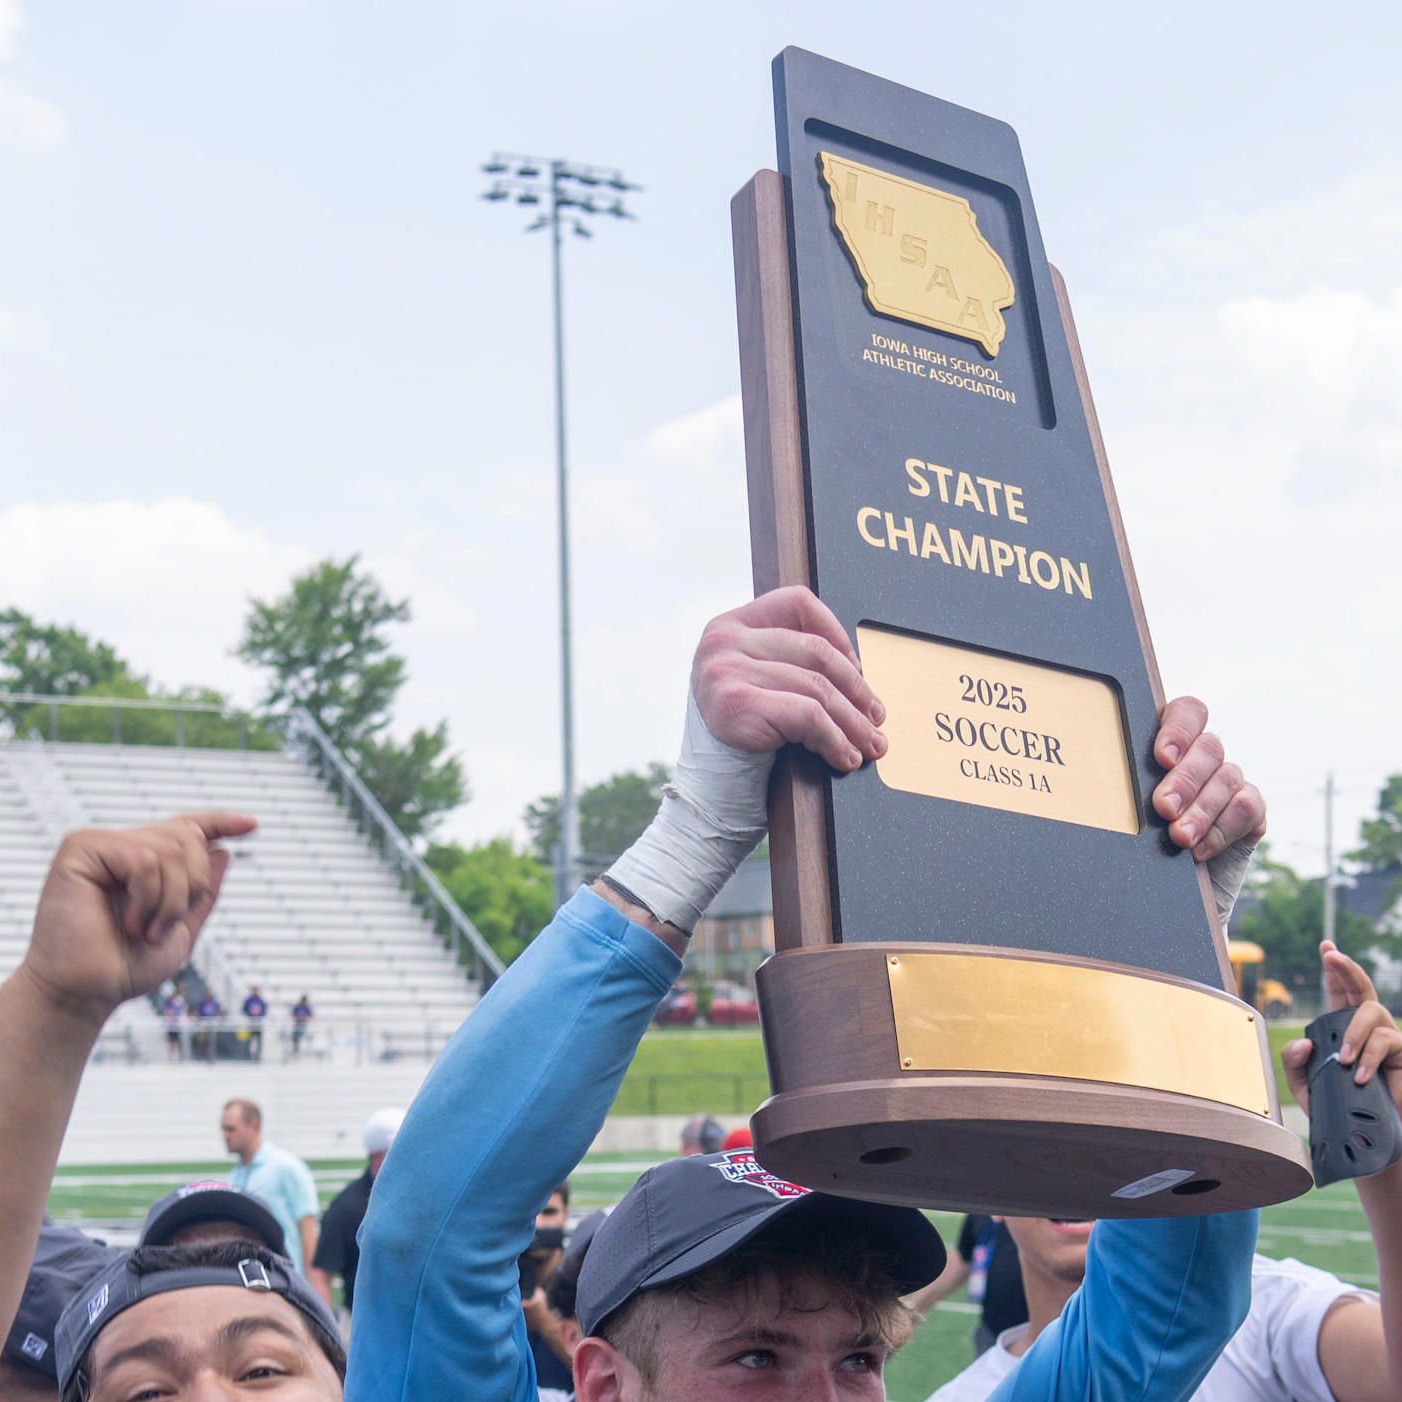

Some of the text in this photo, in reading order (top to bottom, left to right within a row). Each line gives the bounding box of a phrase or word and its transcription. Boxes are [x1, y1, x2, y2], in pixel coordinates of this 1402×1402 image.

[845, 172, 992, 333] IHSAA
[862, 349, 1016, 404] ATHLETIC ASSOCIATION
[871, 333, 1003, 383] IOWA HIGH SCHOOL
[904, 457, 1029, 524] STATE
[856, 506, 1093, 600] CHAMPION
[959, 674, 1027, 714] 2025
[934, 712, 1066, 766] SOCCER
[959, 758, 1053, 793] CLASS 1A
